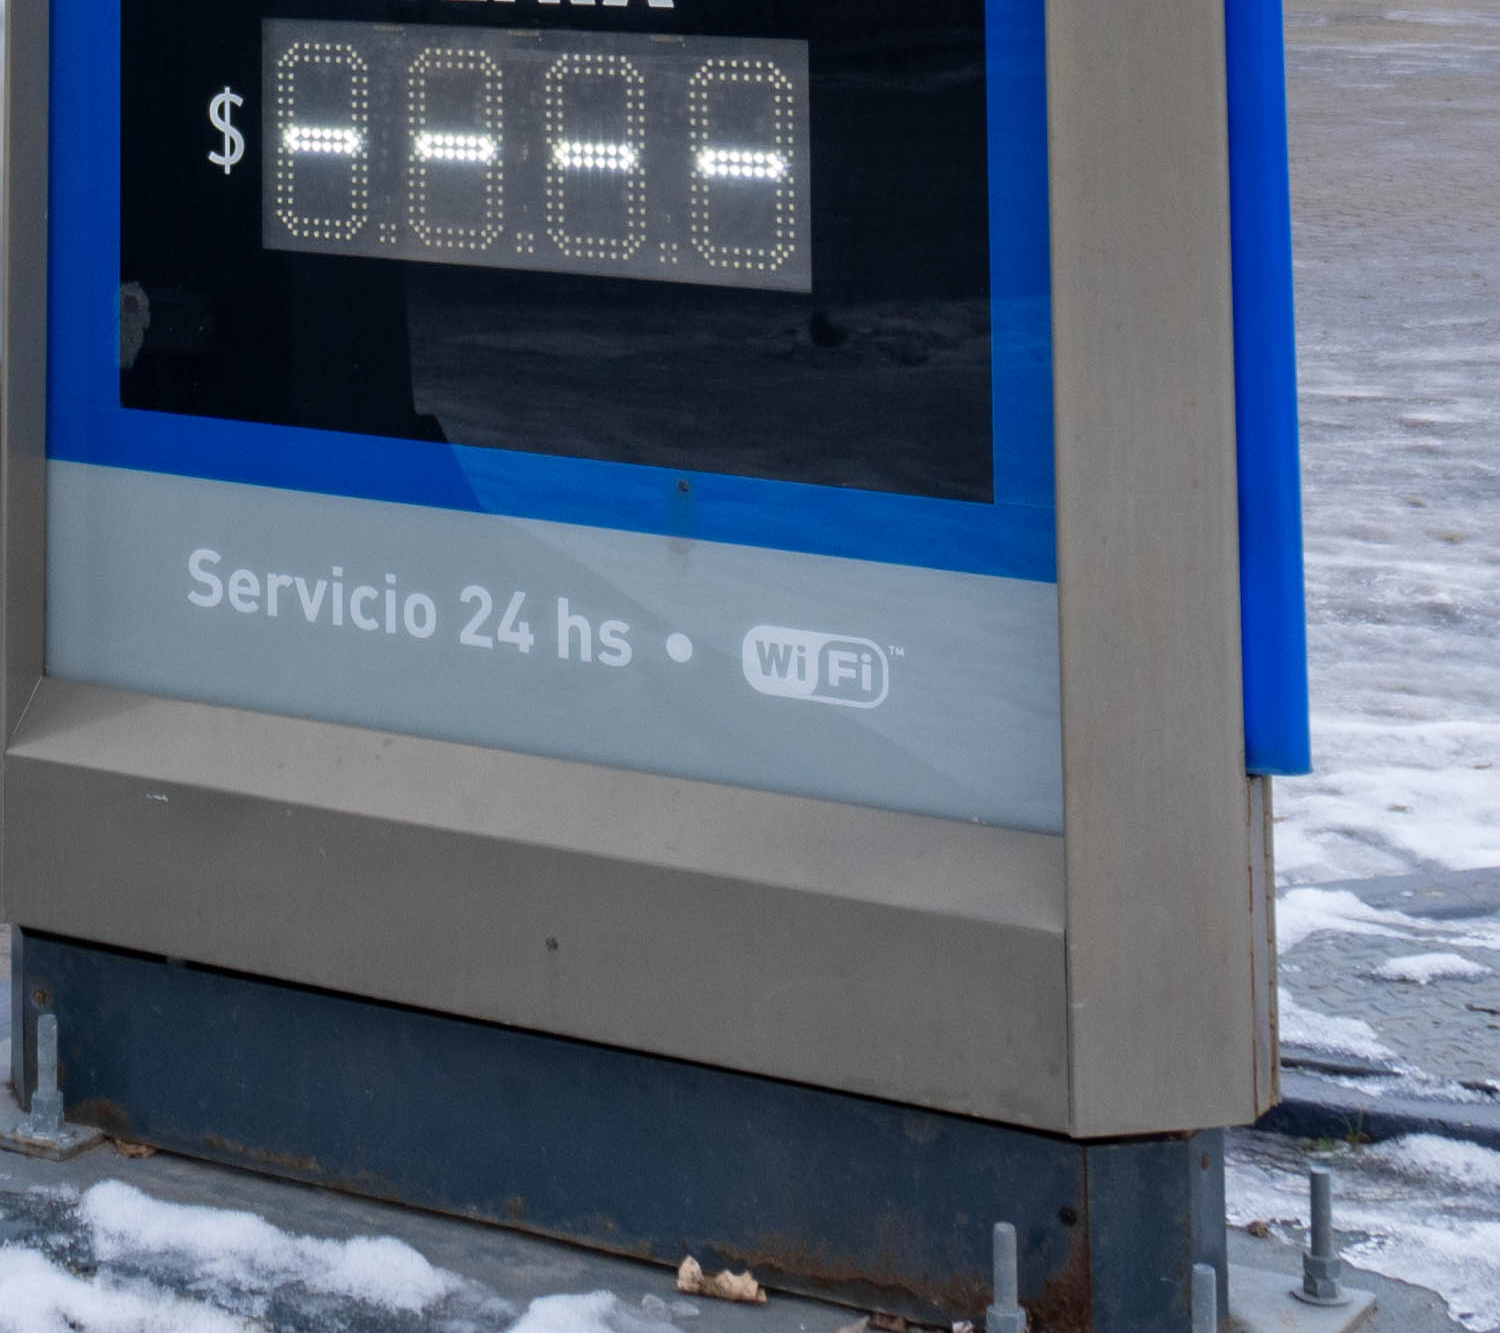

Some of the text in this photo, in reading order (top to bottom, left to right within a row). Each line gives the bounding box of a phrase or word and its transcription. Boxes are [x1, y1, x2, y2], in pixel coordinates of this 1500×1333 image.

[207, 86, 245, 175] $
[186, 547, 634, 668] Servicio 24 hs
